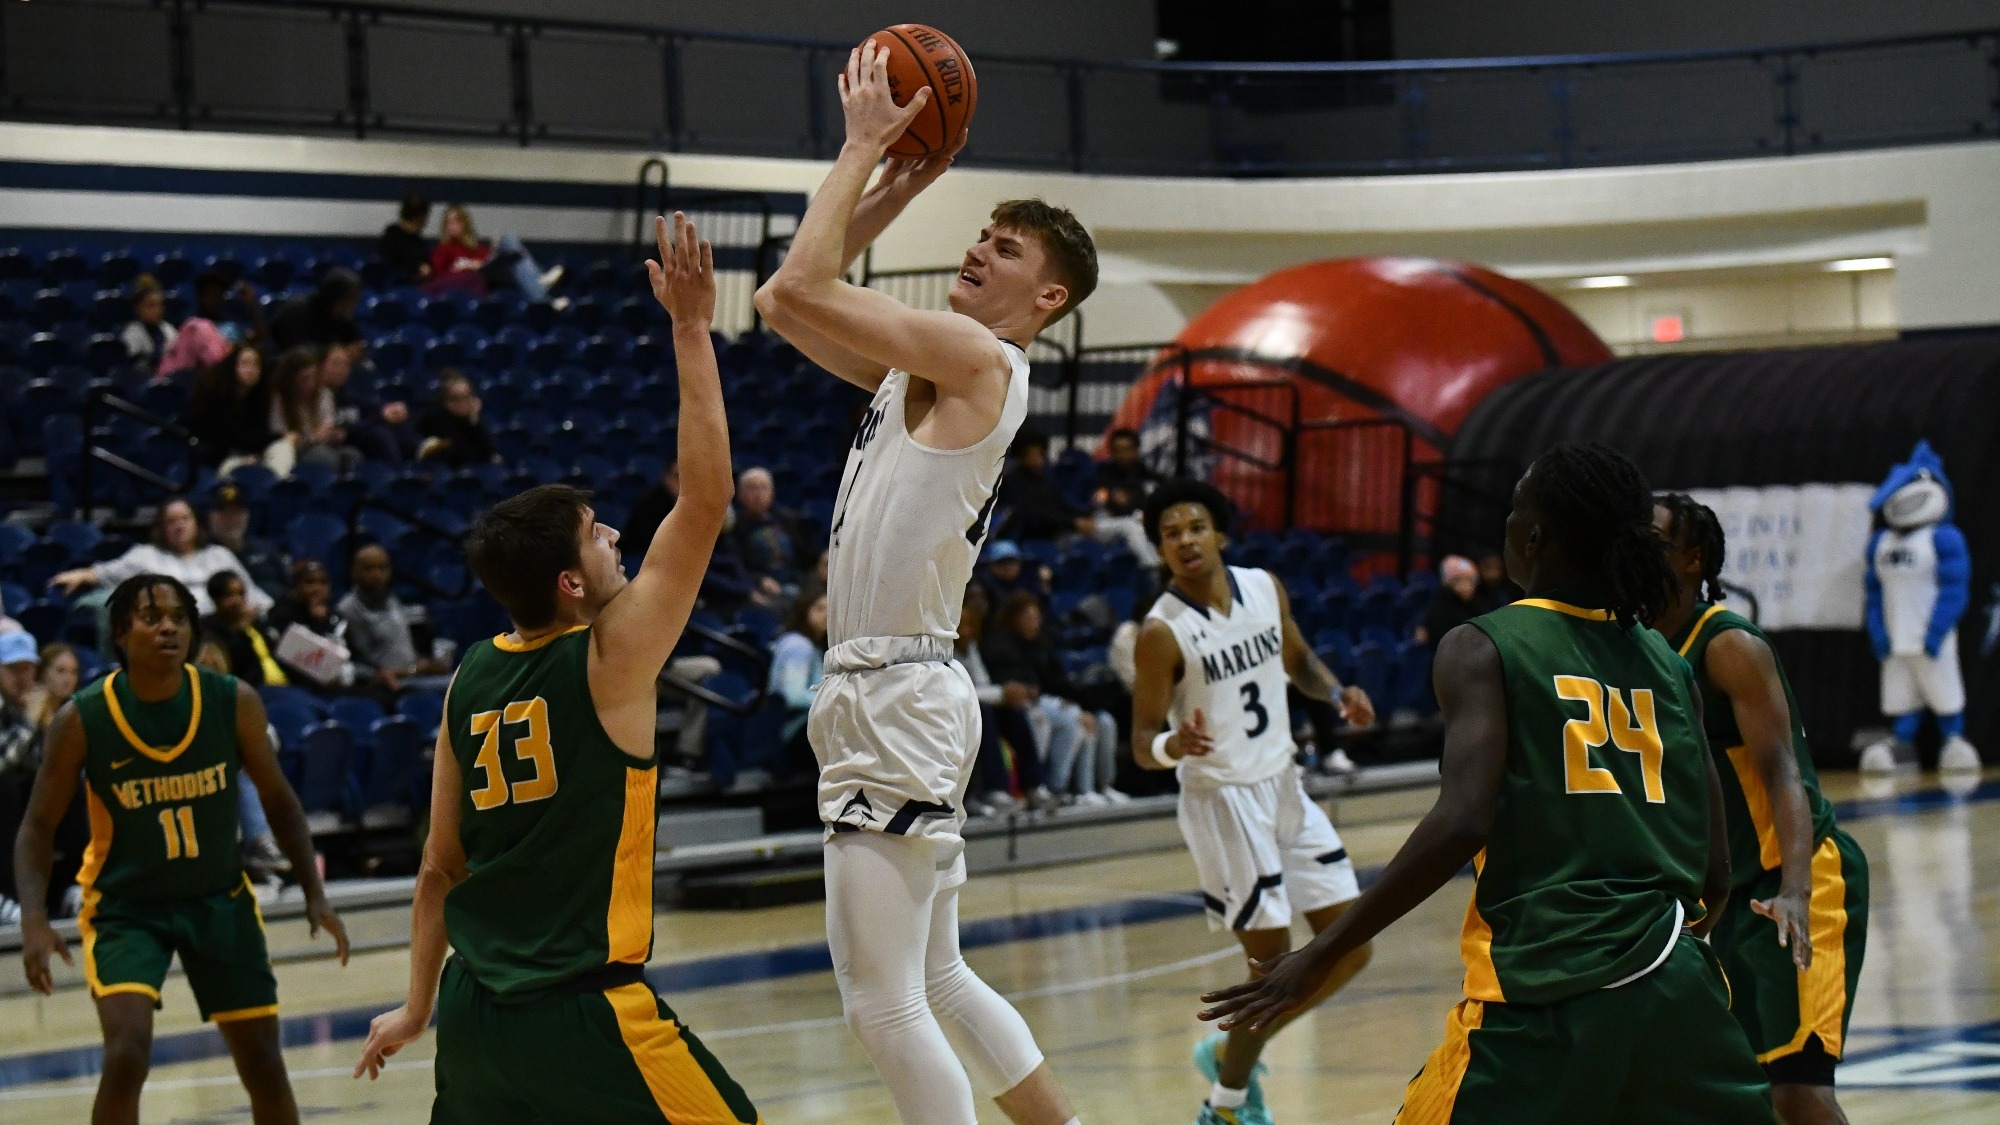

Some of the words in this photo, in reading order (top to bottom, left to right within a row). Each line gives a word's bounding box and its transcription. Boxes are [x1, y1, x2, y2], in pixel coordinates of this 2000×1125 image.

[908, 27, 943, 53] THE
[934, 56, 963, 107] ROCK
[1201, 626, 1280, 685] MARLINS
[1239, 681, 1269, 739] 3
[1553, 674, 1666, 804] 24
[470, 695, 559, 811] 33
[158, 806, 199, 860] 11
